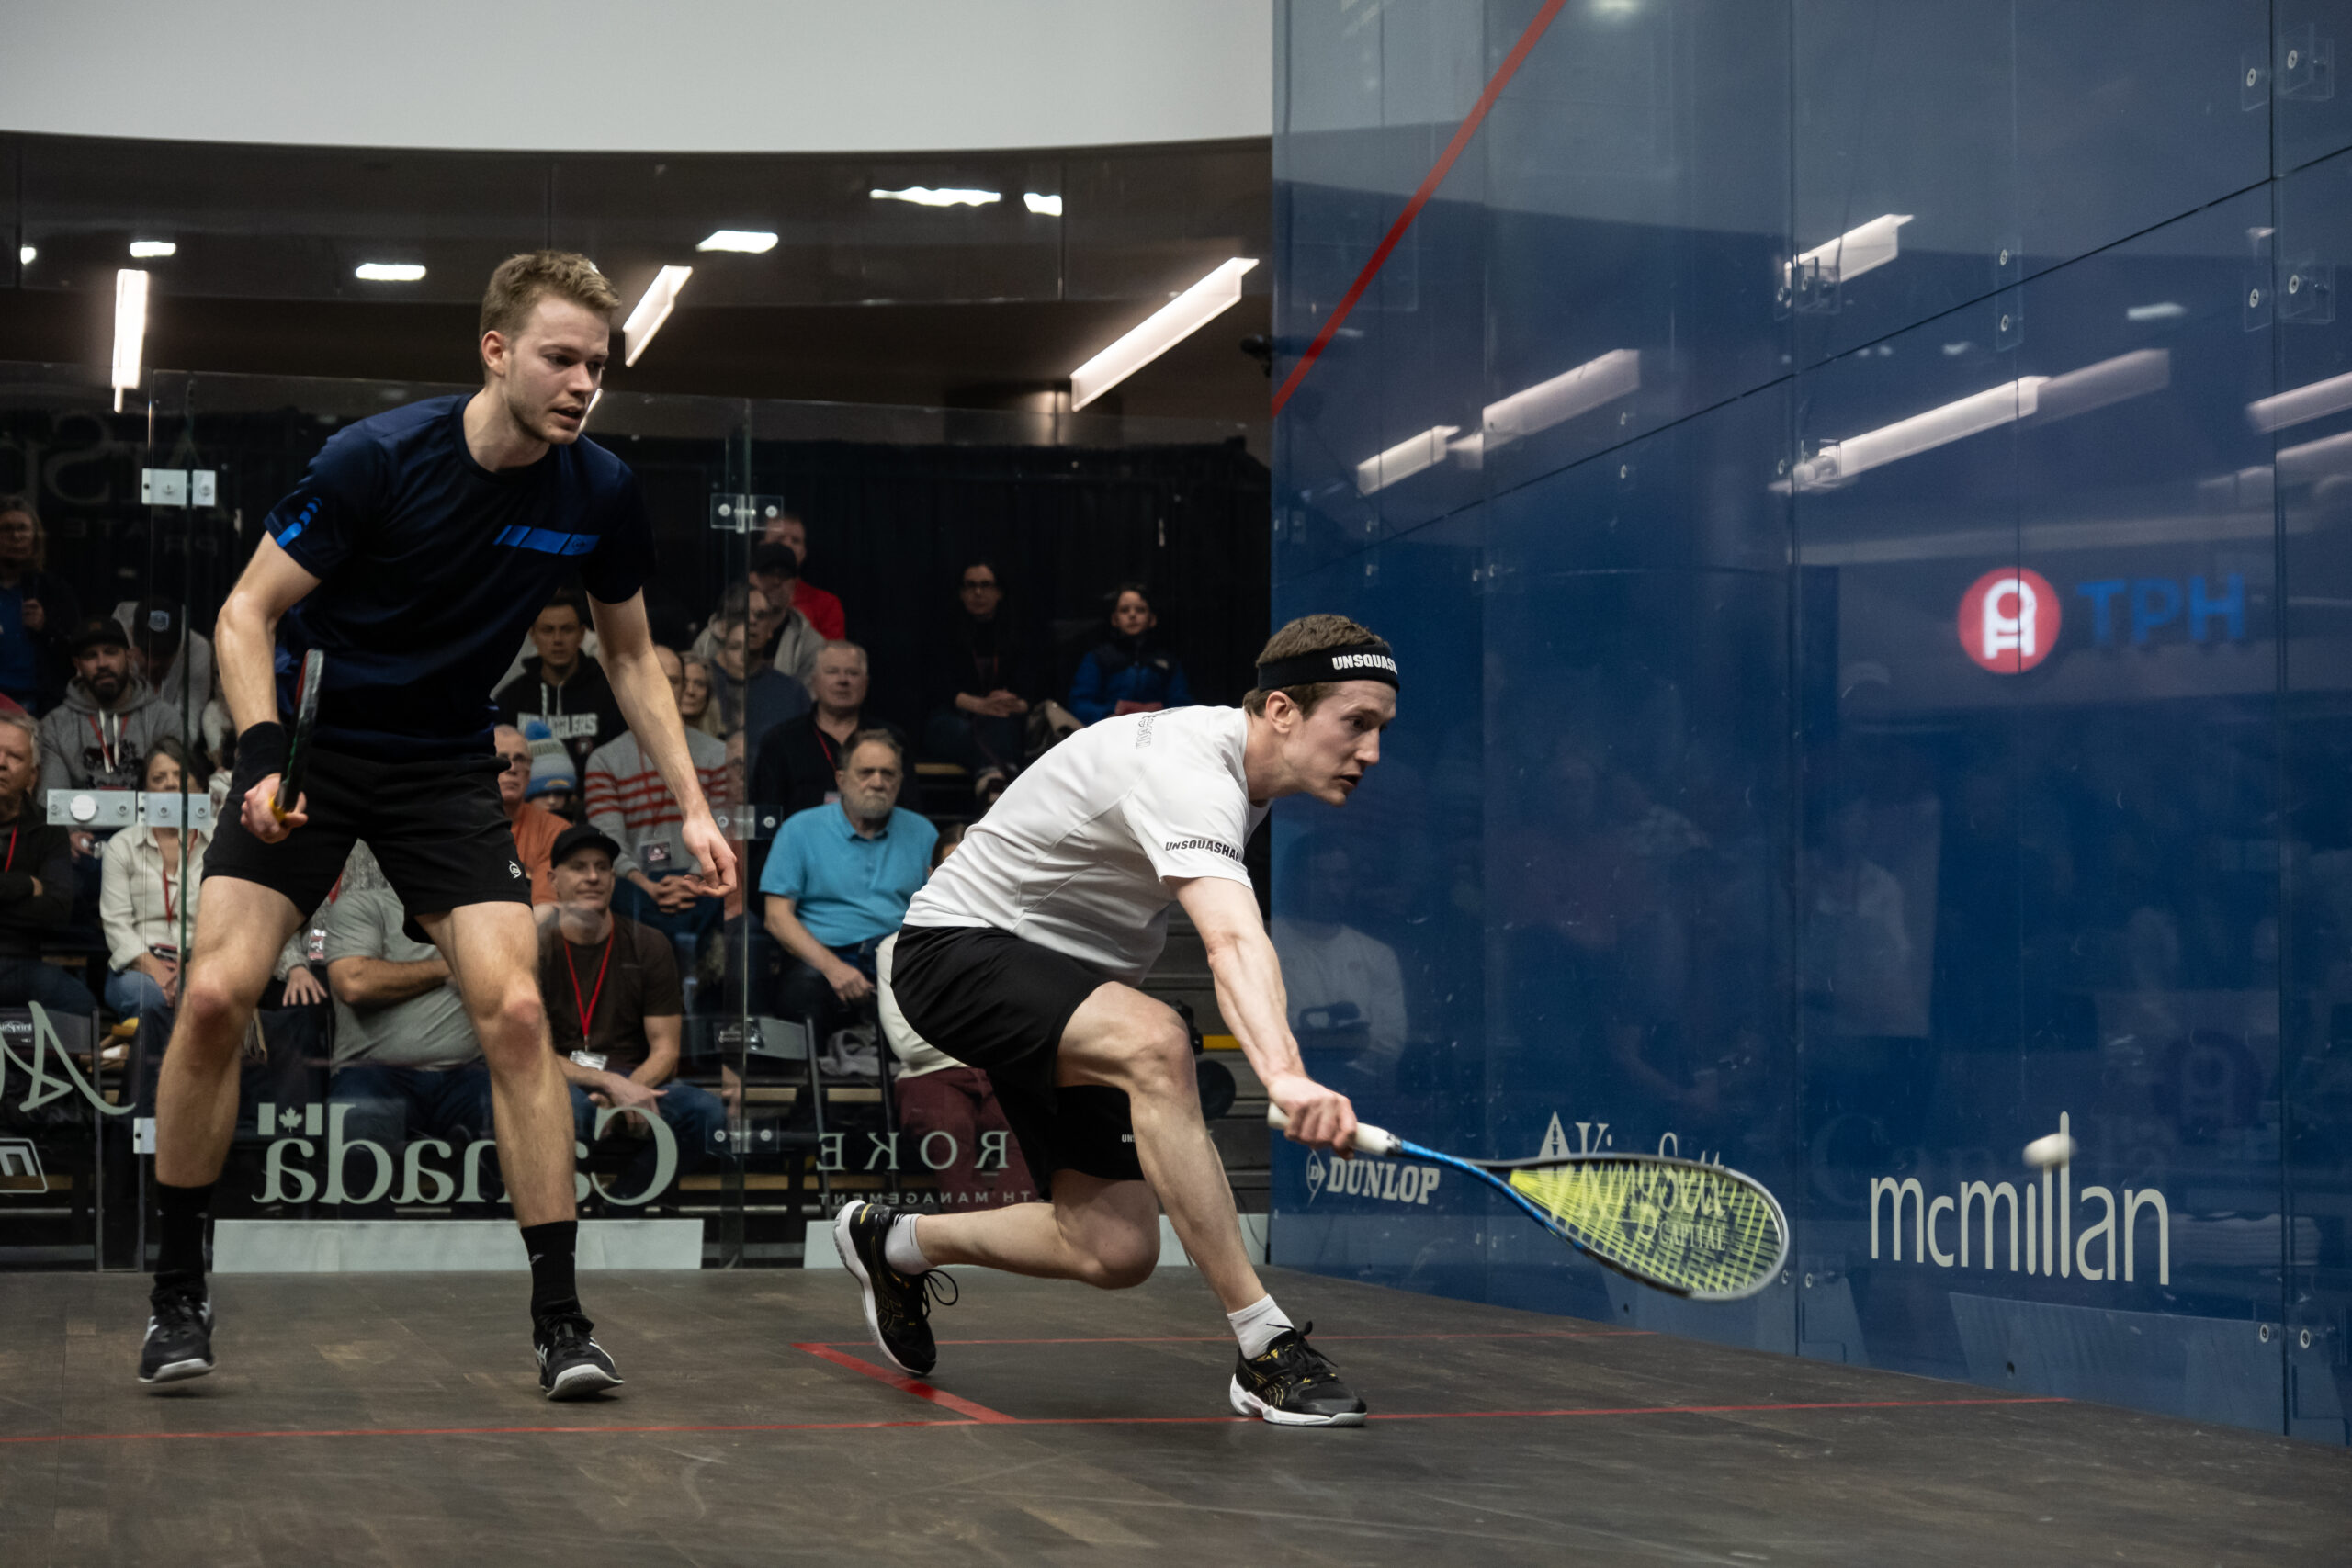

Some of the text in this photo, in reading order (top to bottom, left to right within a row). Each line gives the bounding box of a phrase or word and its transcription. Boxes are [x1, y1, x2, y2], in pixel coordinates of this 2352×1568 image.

[2076, 572, 2245, 646] TPH
[1326, 1156, 1441, 1205] DUNLOP
[1870, 1111, 2169, 1286] mcmillan
[1658, 1219, 1726, 1252] CAPITAL
